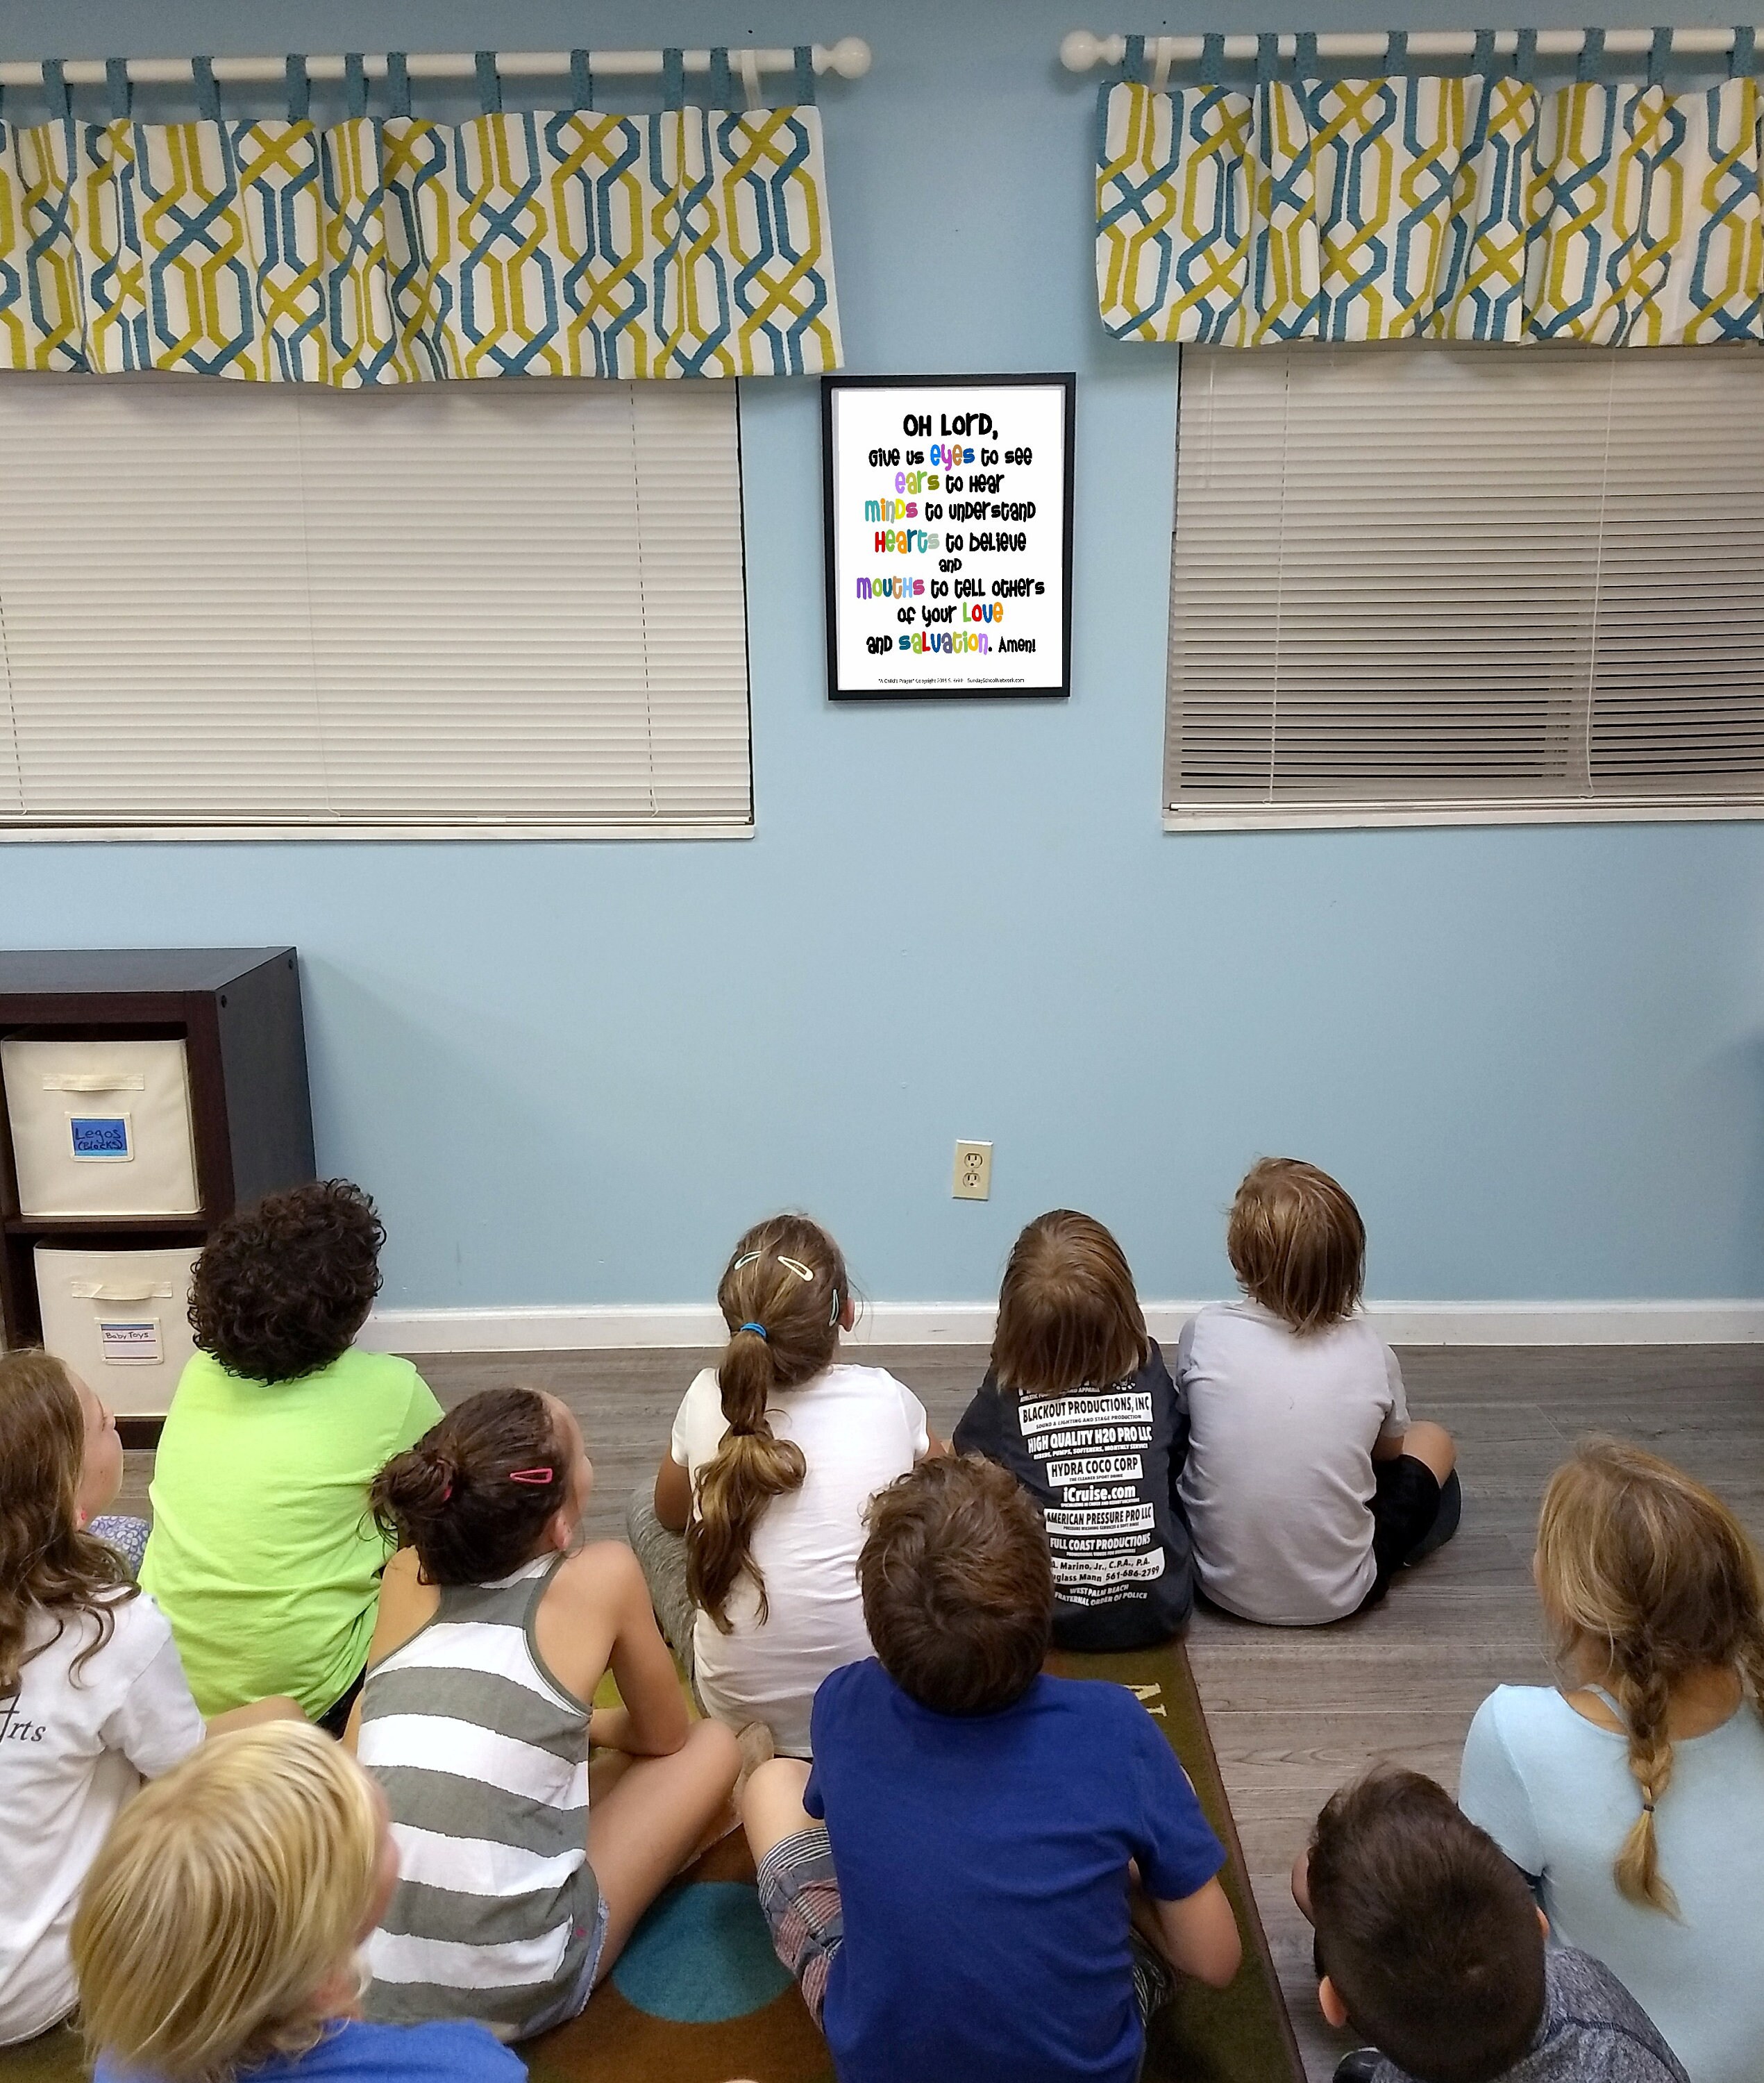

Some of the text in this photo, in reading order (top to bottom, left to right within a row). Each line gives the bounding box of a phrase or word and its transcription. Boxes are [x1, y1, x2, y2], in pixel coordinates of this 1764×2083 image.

[906, 451, 924, 465] us
[930, 444, 975, 471] eyes
[981, 448, 998, 467] to
[1005, 447, 1032, 465] see
[895, 471, 940, 494] ears
[946, 474, 964, 494] to
[925, 502, 943, 521] to
[946, 533, 964, 553] to
[931, 579, 948, 599] to
[897, 607, 916, 625] of
[922, 605, 957, 628] your
[75, 1128, 121, 1144] Legos
[1023, 1396, 1150, 1423] BLACKOUT PRODUCTIONS, INC
[1036, 1421, 1052, 1430] SOUND
[1027, 1434, 1049, 1454] HIGH
[1050, 1430, 1093, 1448] QUALITY
[1117, 1426, 1138, 1442] PRO
[1138, 1425, 1153, 1441] LLC
[1051, 1457, 1138, 1478] HYDRA COCO CORP
[1064, 1484, 1136, 1503] iCruise.com
[1047, 1506, 1152, 1525] AMERICAN PRESSURE PRO LLC
[1050, 1532, 1151, 1551] FULL COAST PRODUCTIONS
[1060, 1562, 1092, 1571] Marino,
[1136, 1557, 1150, 1566] P.A.
[1080, 1573, 1102, 1582] Mann
[1105, 1565, 1160, 1581] 561-686-2799
[1055, 1591, 1090, 1606] FRATERNAL
[1090, 1596, 1113, 1606] ORDER
[1114, 1593, 1122, 1602] OF
[1088, 1588, 1107, 1597] PALM
[1107, 1584, 1129, 1594] BEACH
